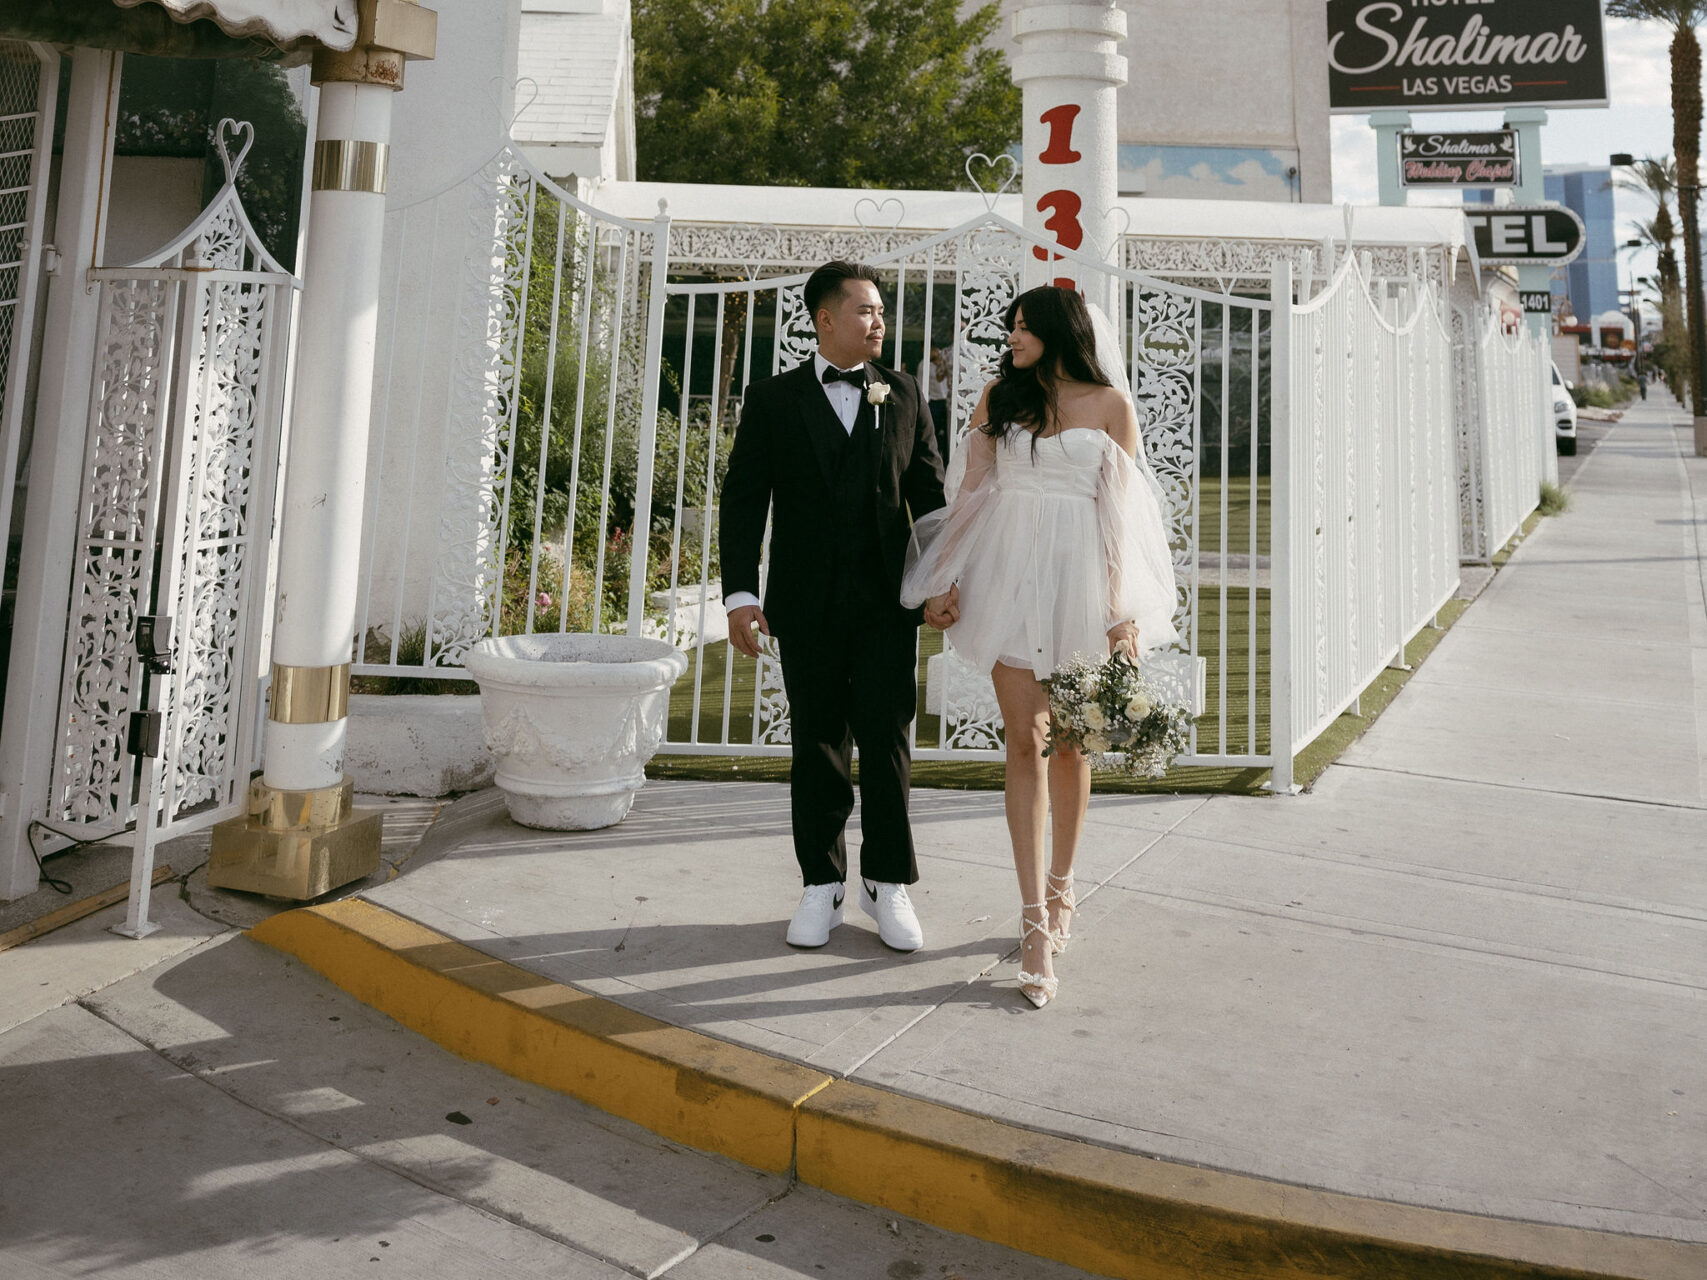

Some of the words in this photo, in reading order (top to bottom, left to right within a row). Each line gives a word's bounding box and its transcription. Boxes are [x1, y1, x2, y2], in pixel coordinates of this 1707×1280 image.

[1328, 2, 1588, 75] Shalimar
[1402, 77, 1439, 96] LAS
[1442, 75, 1513, 94] VEGAS
[1419, 135, 1498, 156] Shalimar
[1405, 161, 1463, 183] Wedding
[1465, 159, 1513, 182] Chapel
[1032, 104, 1084, 300] 13
[1521, 294, 1550, 310] 1401
